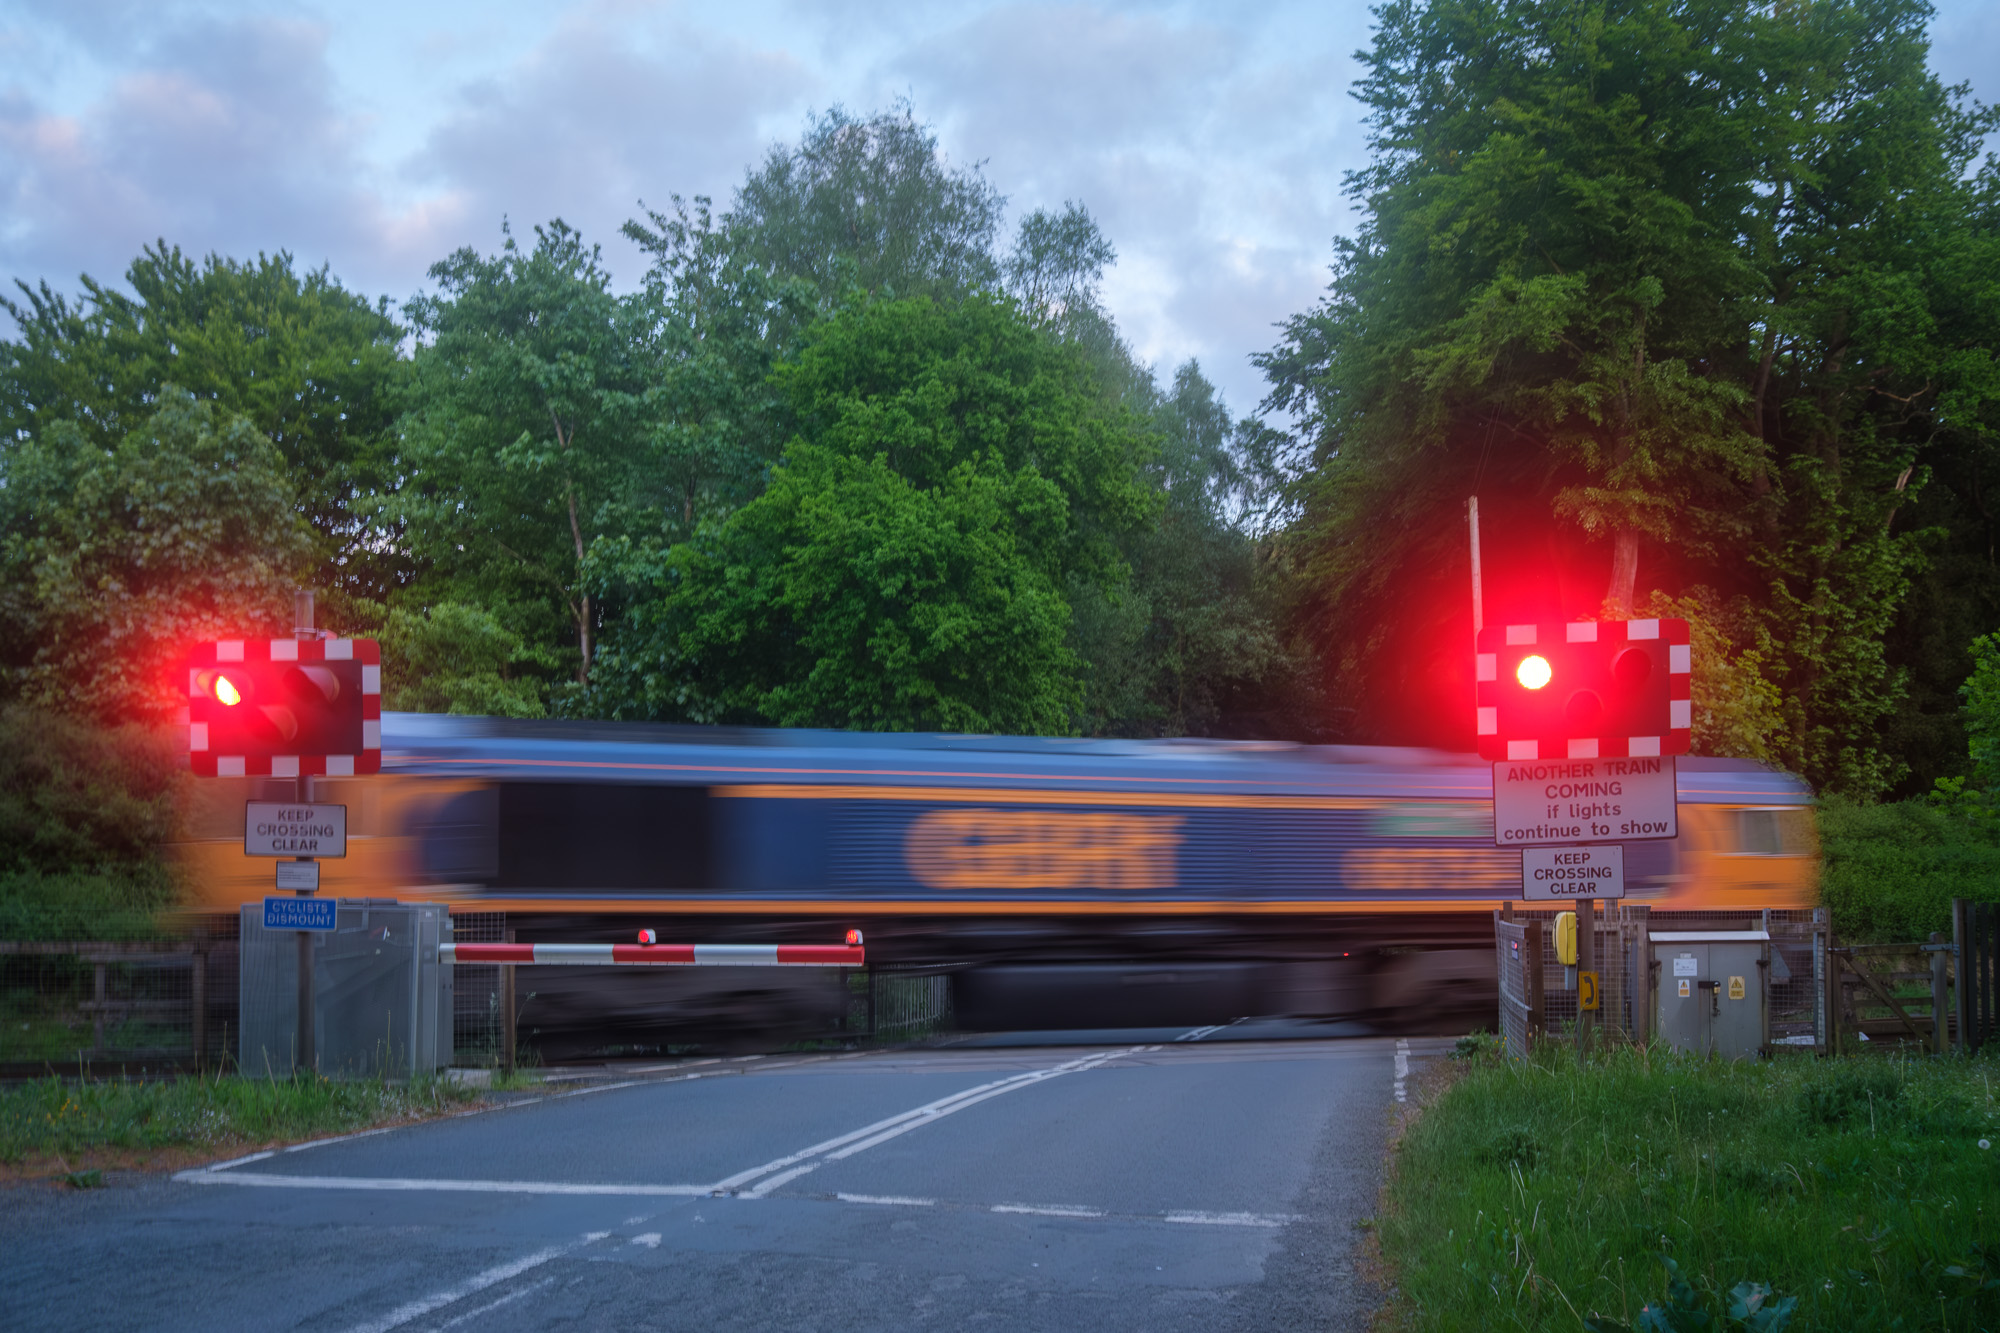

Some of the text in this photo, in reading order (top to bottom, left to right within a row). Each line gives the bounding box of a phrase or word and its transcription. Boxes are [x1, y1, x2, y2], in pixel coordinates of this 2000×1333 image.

[1507, 758, 1661, 782] ANOTHER TRAIN
[1545, 781, 1622, 799] COMING
[278, 809, 314, 822] KEEP
[1547, 802, 1622, 820] if lights
[257, 823, 334, 838] CROSSING
[1504, 820, 1668, 840] continue to show
[272, 839, 319, 851] CLEAR
[1554, 852, 1591, 865] KEEP
[1534, 866, 1612, 880] CROSSING
[1550, 882, 1597, 895] CLEAR
[272, 901, 328, 914] CYCLISTS
[267, 913, 331, 926] DISMOUNT
